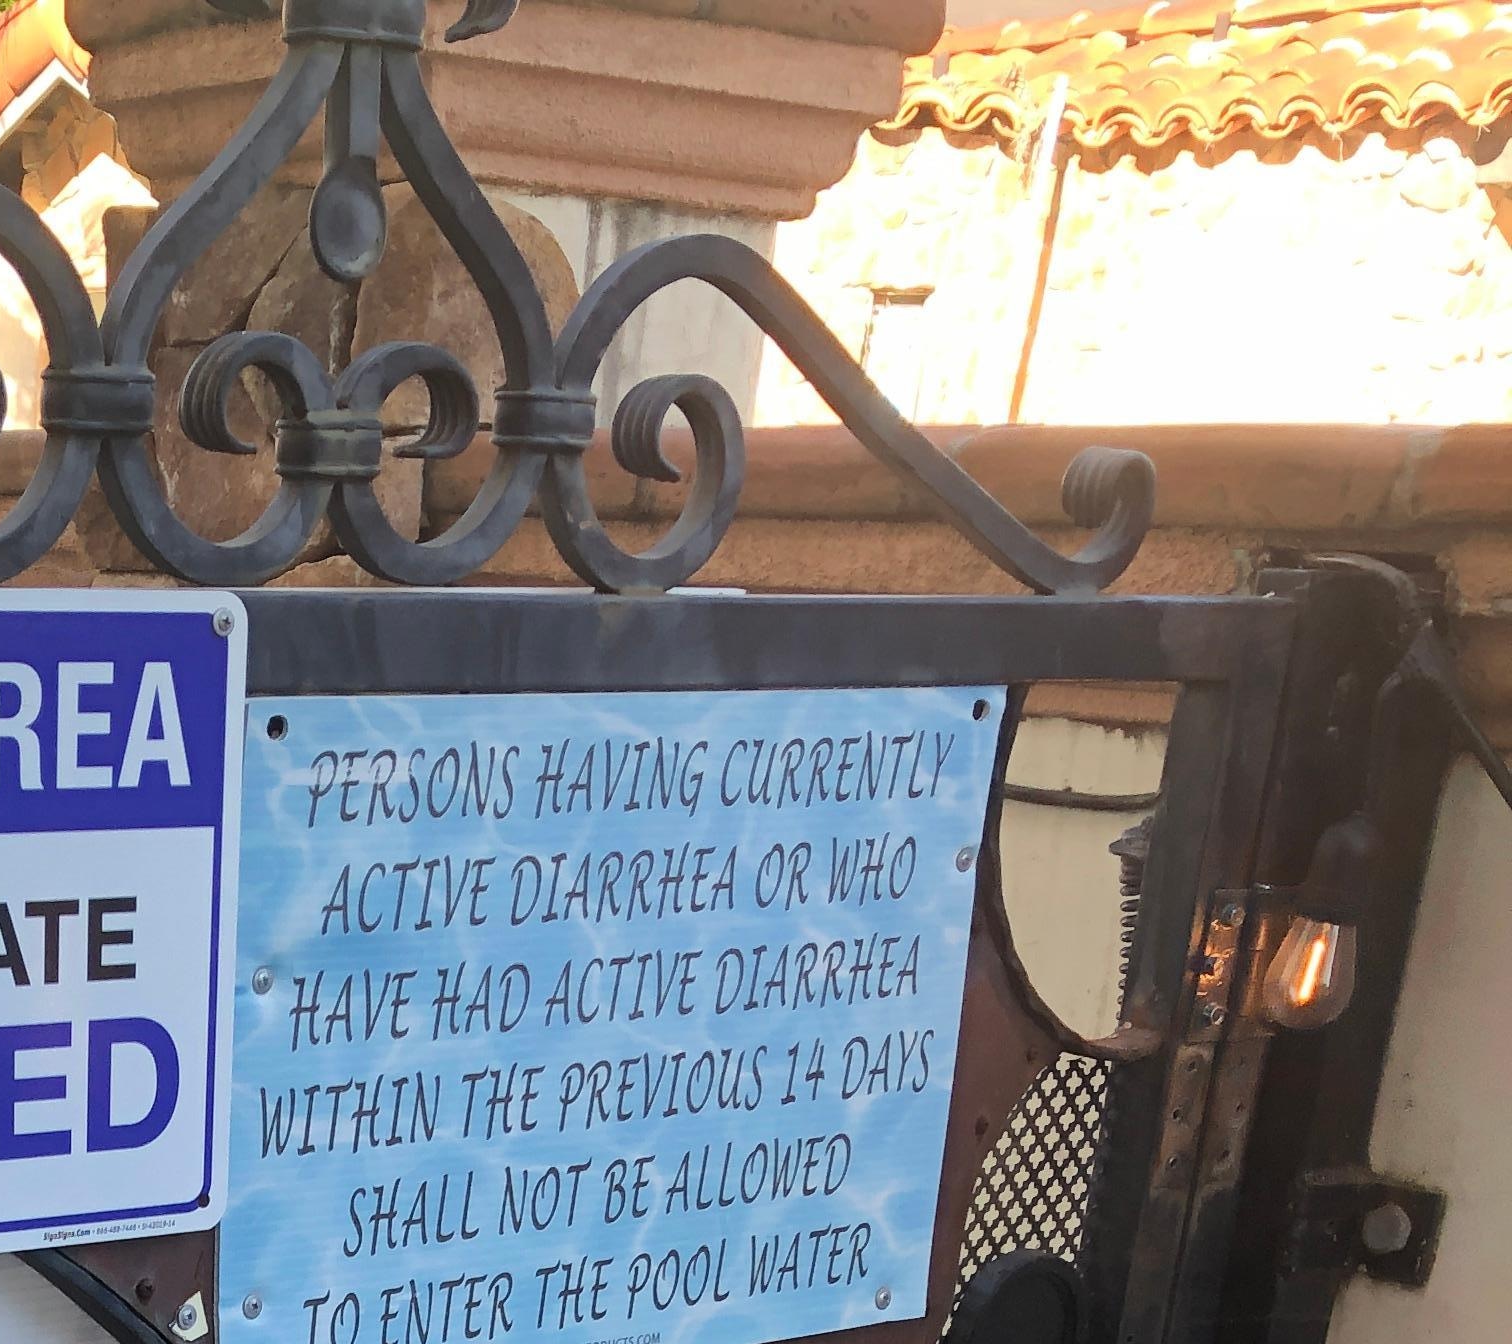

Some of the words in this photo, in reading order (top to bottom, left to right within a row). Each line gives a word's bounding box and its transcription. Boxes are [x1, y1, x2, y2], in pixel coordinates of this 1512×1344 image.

[308, 743, 520, 828] PERSONS
[535, 736, 709, 819] HAVING
[720, 730, 955, 808] CURRENTLY
[321, 855, 496, 936] ACTIVE
[511, 841, 737, 927] DIARRHEA
[756, 841, 812, 910] OR
[827, 832, 916, 906] WHO
[289, 968, 418, 1052] HAVE
[431, 961, 531, 1040] HAD
[545, 949, 703, 1027] ACTIVE
[715, 933, 921, 1015] DIARRHEA
[260, 1071, 441, 1158] WITHIN
[462, 1063, 545, 1140] THE
[559, 1045, 767, 1133] PREVIOUS
[780, 1039, 825, 1106] 14
[842, 1030, 935, 1099] DAYS
[343, 1172, 480, 1257] SHALL
[498, 1157, 592, 1235] NOT
[603, 1155, 656, 1225] BE
[666, 1133, 852, 1215] ALLOWED
[535, 1256, 614, 1331] THE
[628, 1239, 729, 1319] POOL
[747, 1223, 872, 1296] WATER
